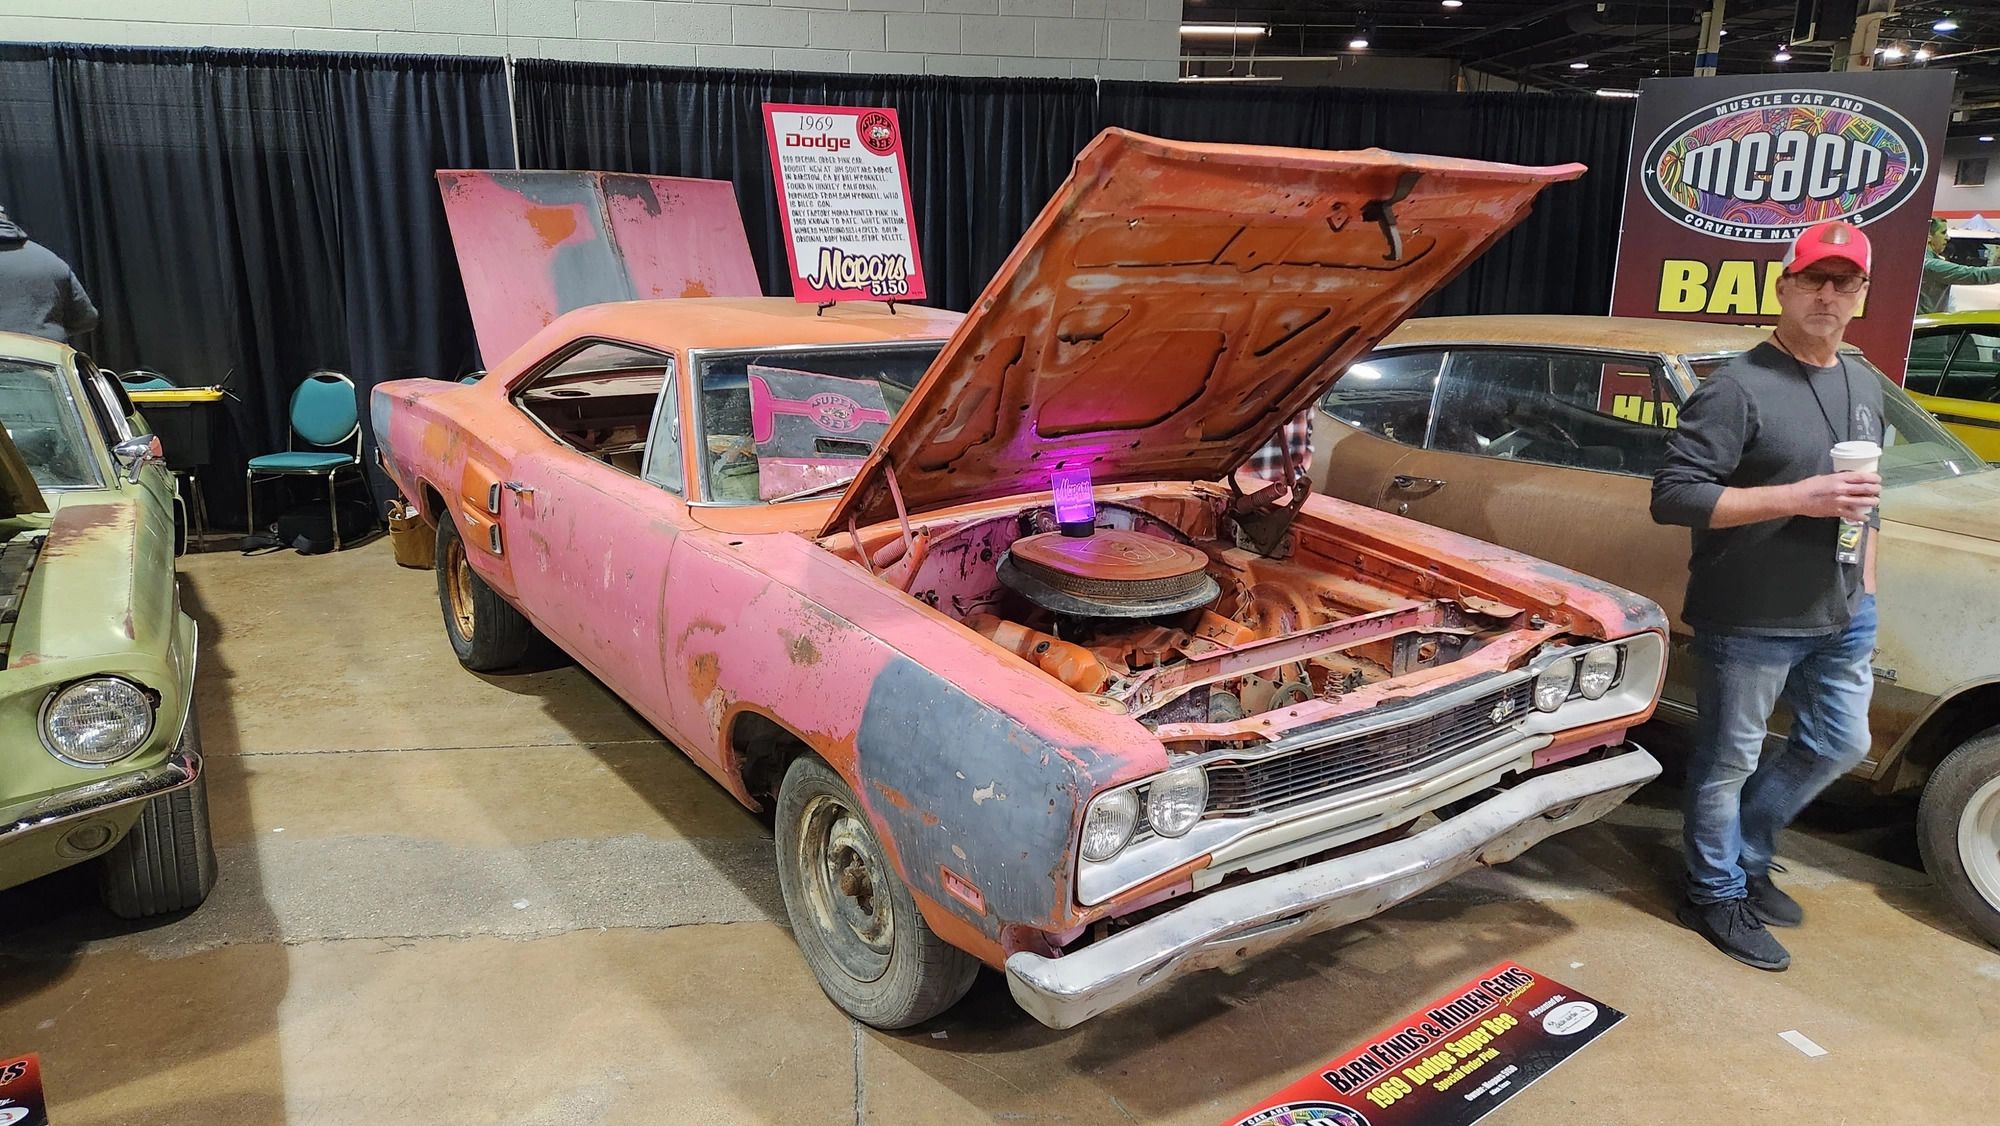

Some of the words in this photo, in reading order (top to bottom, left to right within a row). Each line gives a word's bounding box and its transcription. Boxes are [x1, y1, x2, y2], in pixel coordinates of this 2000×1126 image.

[1716, 94, 1782, 116] MUSCLE
[1791, 94, 1826, 105] CAR
[1830, 97, 1864, 112] AND
[799, 115, 833, 131] 1969
[863, 114, 892, 131] SUPER
[785, 133, 851, 152] Dodge
[869, 137, 892, 149] BEE
[795, 155, 817, 164] SPECIAL
[819, 155, 836, 164] ORDER
[838, 155, 850, 164] PINK
[784, 165, 806, 173] BOUGHT
[809, 165, 822, 173] NEW
[824, 165, 831, 173] AT
[873, 165, 893, 173] DODGE
[785, 174, 792, 182] IN
[787, 182, 806, 190] FOUND
[807, 182, 814, 190] IN
[820, 192, 838, 200] FROM
[883, 192, 899, 200] WHO
[792, 209, 805, 217] ONLY
[806, 209, 830, 217] FACTORY
[850, 209, 873, 217] PAINTED
[875, 209, 889, 217] PINK
[891, 209, 898, 217] IN
[808, 217, 829, 225] KNOWN
[832, 217, 840, 225] TO
[861, 217, 881, 225] WHITE
[795, 226, 818, 234] NUMBERS
[1684, 213, 1764, 239] CORVETTE
[796, 234, 823, 242] ORIGINAL
[824, 234, 838, 242] BODY
[807, 246, 907, 291] Mopars
[870, 280, 908, 296] 5150
[812, 396, 856, 413] SUPER
[1480, 967, 1534, 998] GEMS
[1427, 990, 1495, 1031] HIDDEN
[1421, 1023, 1444, 1039] &
[1367, 1027, 1430, 1066] FINDS
[1366, 1075, 1413, 1109] 1969
[1402, 1049, 1458, 1087] Dodge
[1444, 1024, 1495, 1059] Super
[1481, 1012, 1519, 1037] Bee
[1323, 1053, 1386, 1093] BARN
[1432, 1068, 1466, 1092] Special
[1460, 1057, 1485, 1075] Order
[1478, 1047, 1501, 1063] Pink
[1247, 1114, 1267, 1125] CAR
[1270, 1106, 1290, 1117] AND
